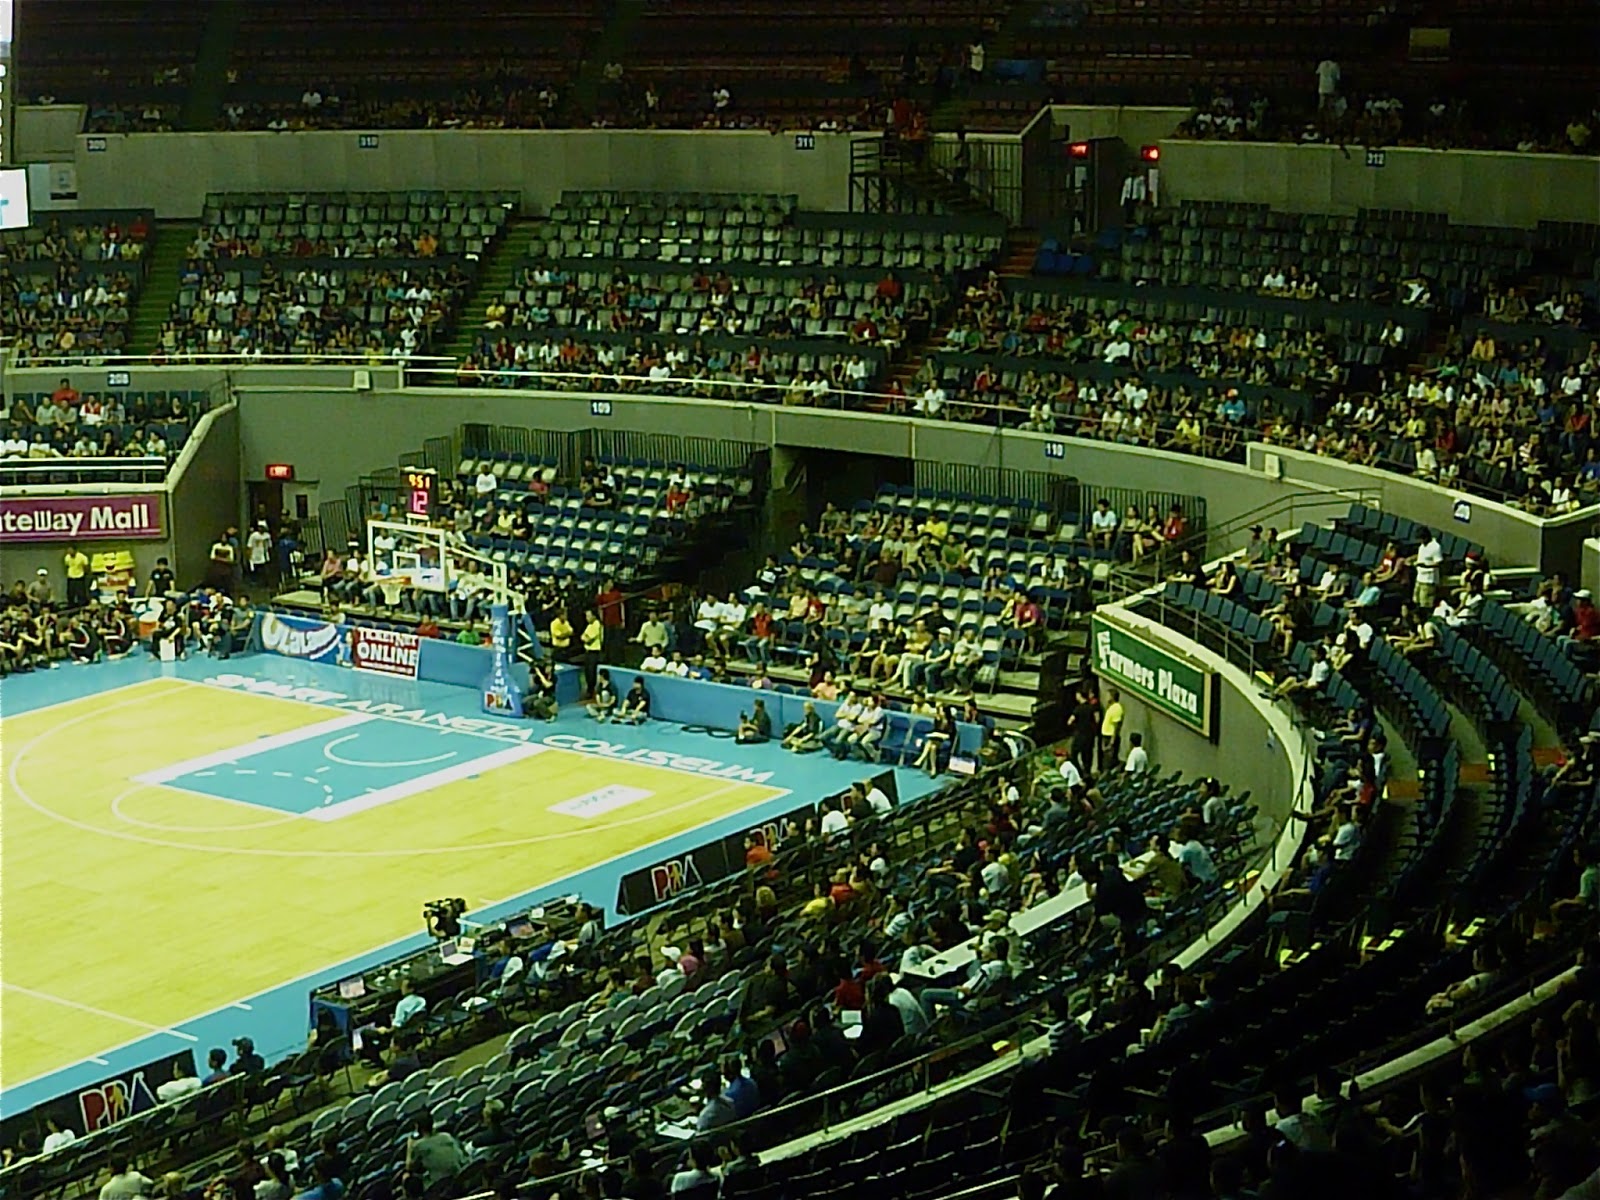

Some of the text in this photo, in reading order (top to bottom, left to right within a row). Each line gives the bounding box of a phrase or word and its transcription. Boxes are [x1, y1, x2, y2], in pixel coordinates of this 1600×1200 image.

[90, 504, 148, 530] Mall
[413, 490, 428, 513] 12
[357, 641, 417, 667] ONLINE
[1157, 667, 1198, 715] Plaza
[335, 699, 534, 741] ARANETA
[542, 734, 775, 783] COLISEUM
[651, 854, 703, 902] PBA
[79, 1071, 158, 1133] PBA
